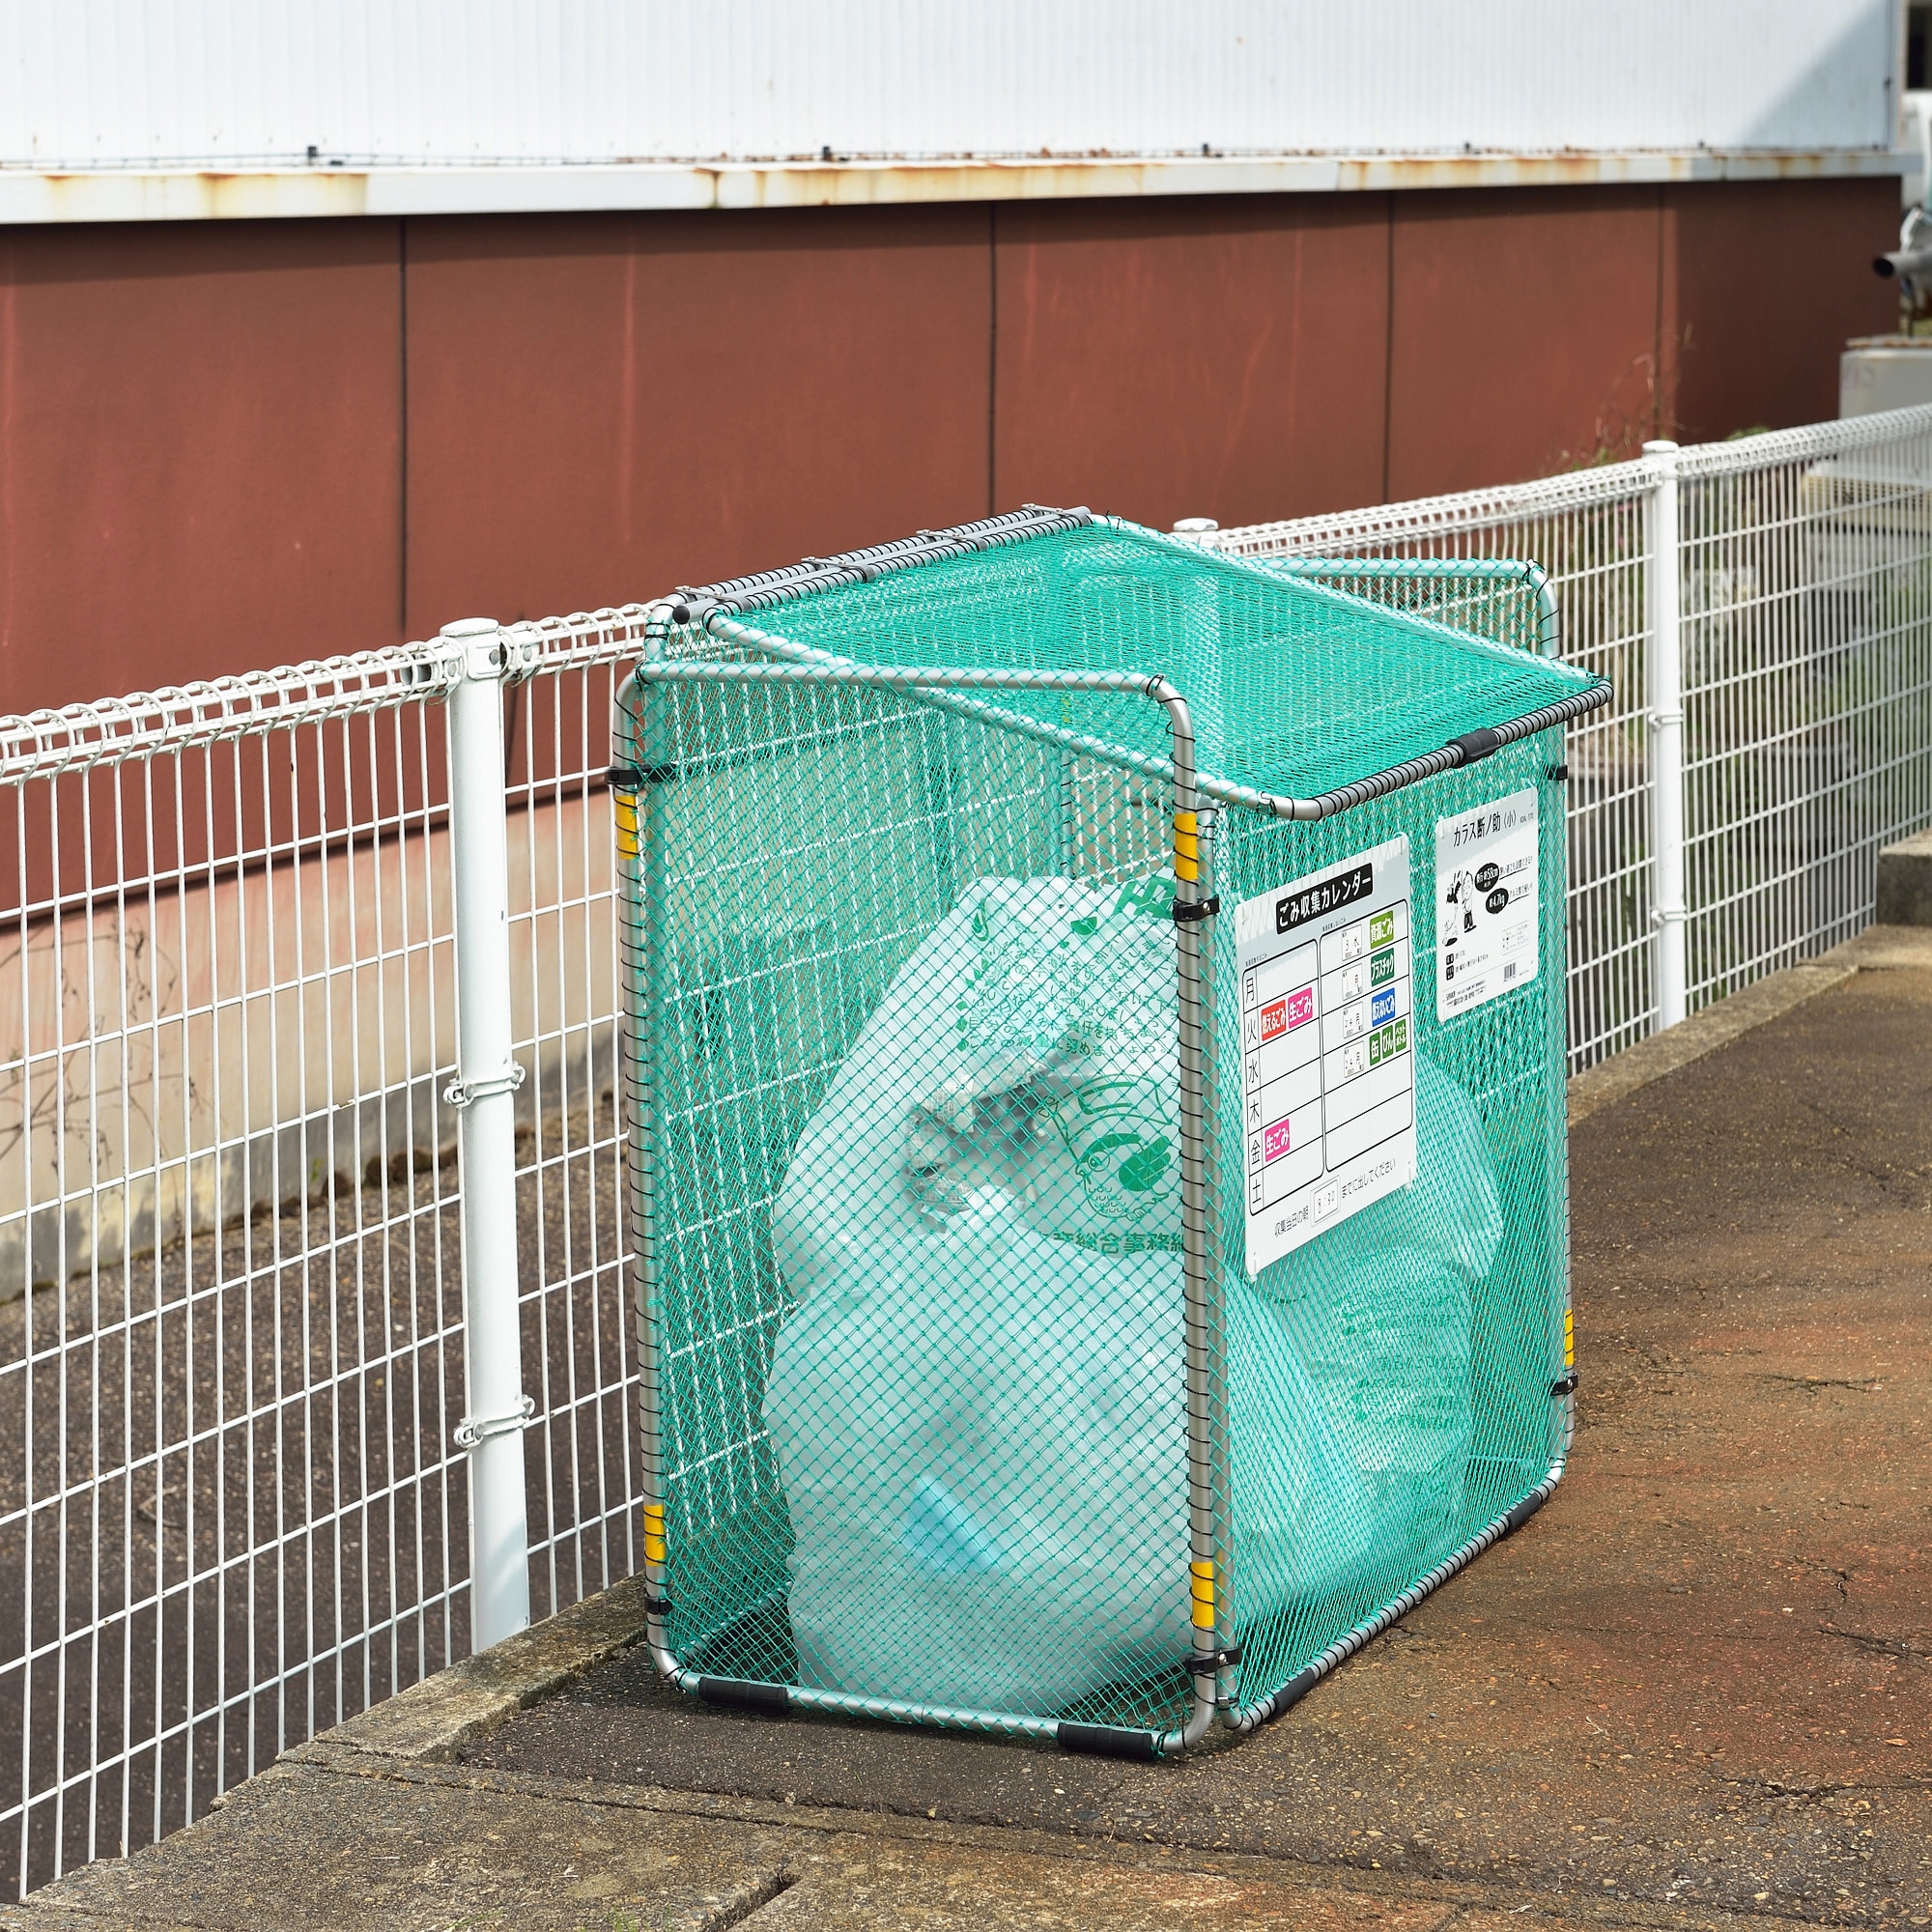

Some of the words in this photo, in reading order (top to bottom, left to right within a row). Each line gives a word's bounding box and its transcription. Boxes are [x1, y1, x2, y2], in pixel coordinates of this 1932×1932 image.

[1278, 871, 1372, 927] ごみ収集カレンダー
[1371, 918, 1394, 944] 資源ごみ
[1372, 953, 1394, 980] プラスチック
[1246, 977, 1255, 1004] 月
[1262, 1007, 1286, 1037] 燃えるごみ
[1289, 995, 1313, 1026] 生ごみ
[1246, 1017, 1257, 1044] 火
[1382, 1031, 1393, 1053] びん
[1371, 1039, 1379, 1060] 缶
[1248, 1058, 1259, 1084] 水
[1249, 1098, 1260, 1123] 木
[1250, 1139, 1261, 1165] 金
[1265, 1126, 1290, 1156] 生ごみ
[1252, 1179, 1262, 1205] 土
[1342, 1158, 1397, 1199] までに出してください
[1274, 1205, 1309, 1237] 収集当日の朝
